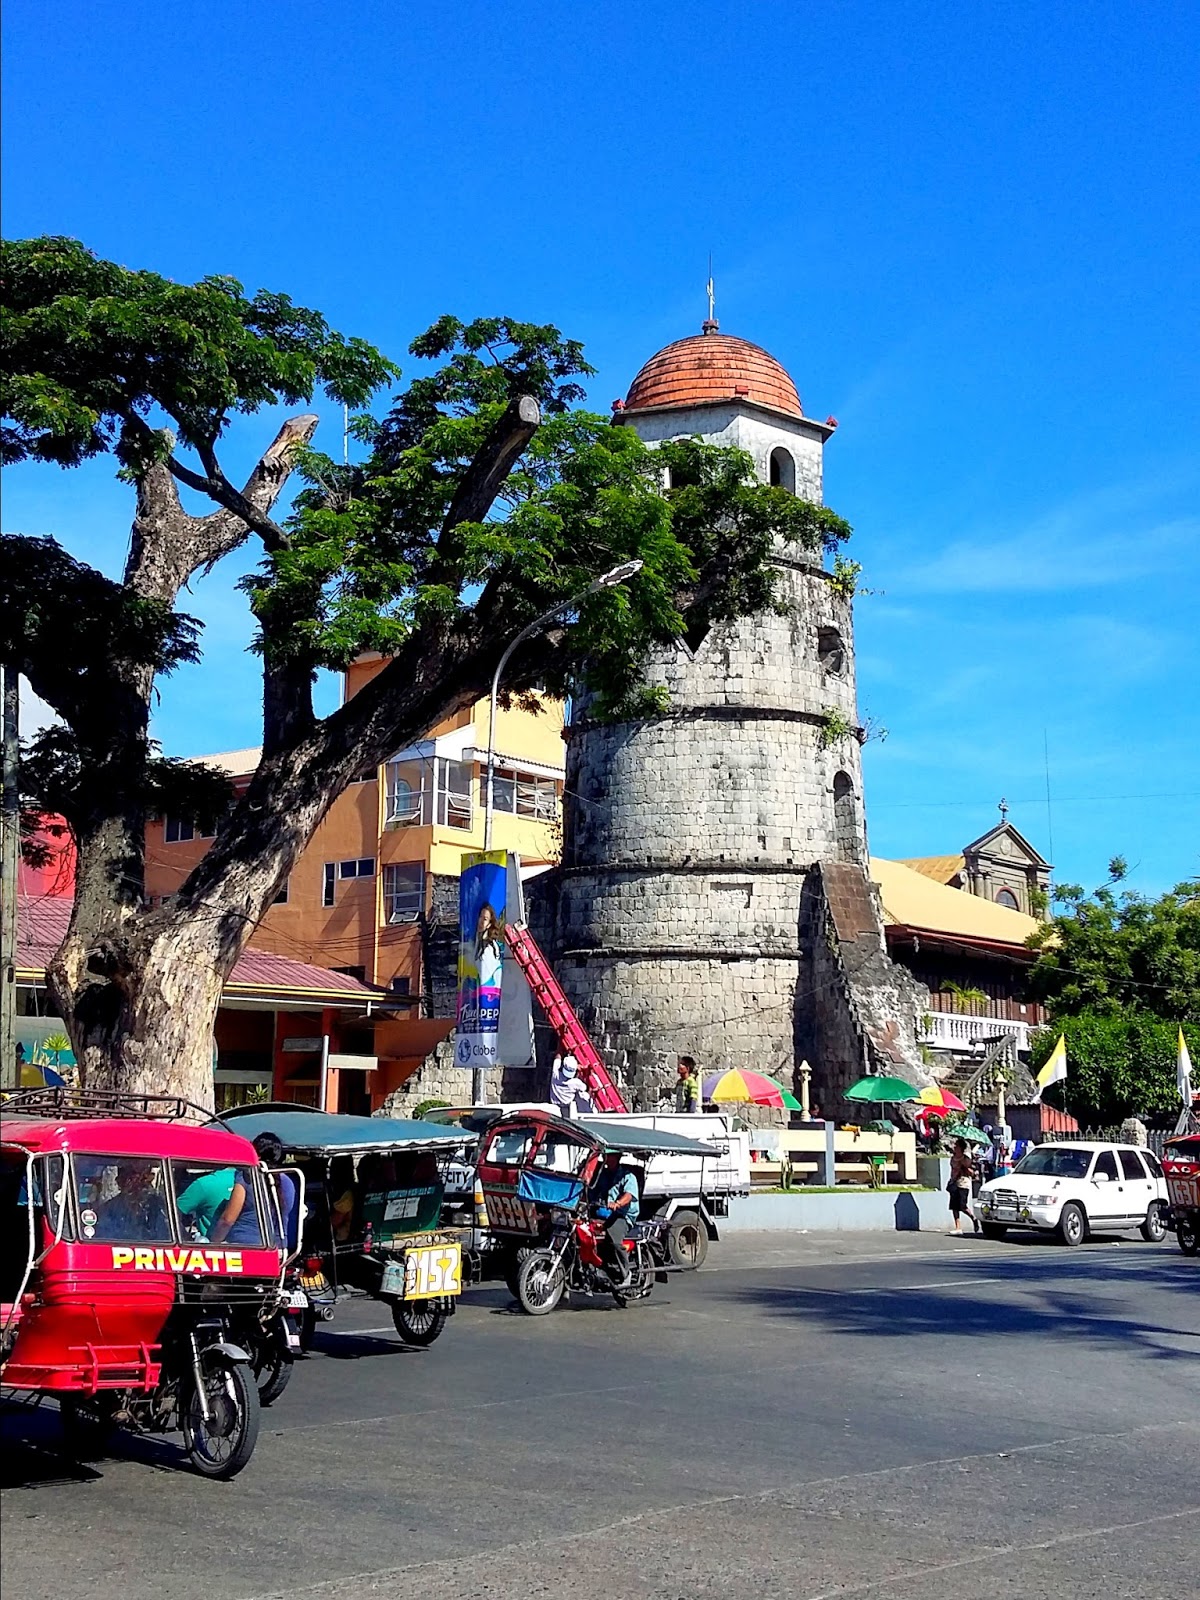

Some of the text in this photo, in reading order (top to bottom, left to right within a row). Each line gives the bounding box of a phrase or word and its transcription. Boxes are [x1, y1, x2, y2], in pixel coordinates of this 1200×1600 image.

[447, 1171, 470, 1184] CITY
[1167, 1180, 1199, 1206] 1637
[112, 1246, 243, 1273] PRIVATE
